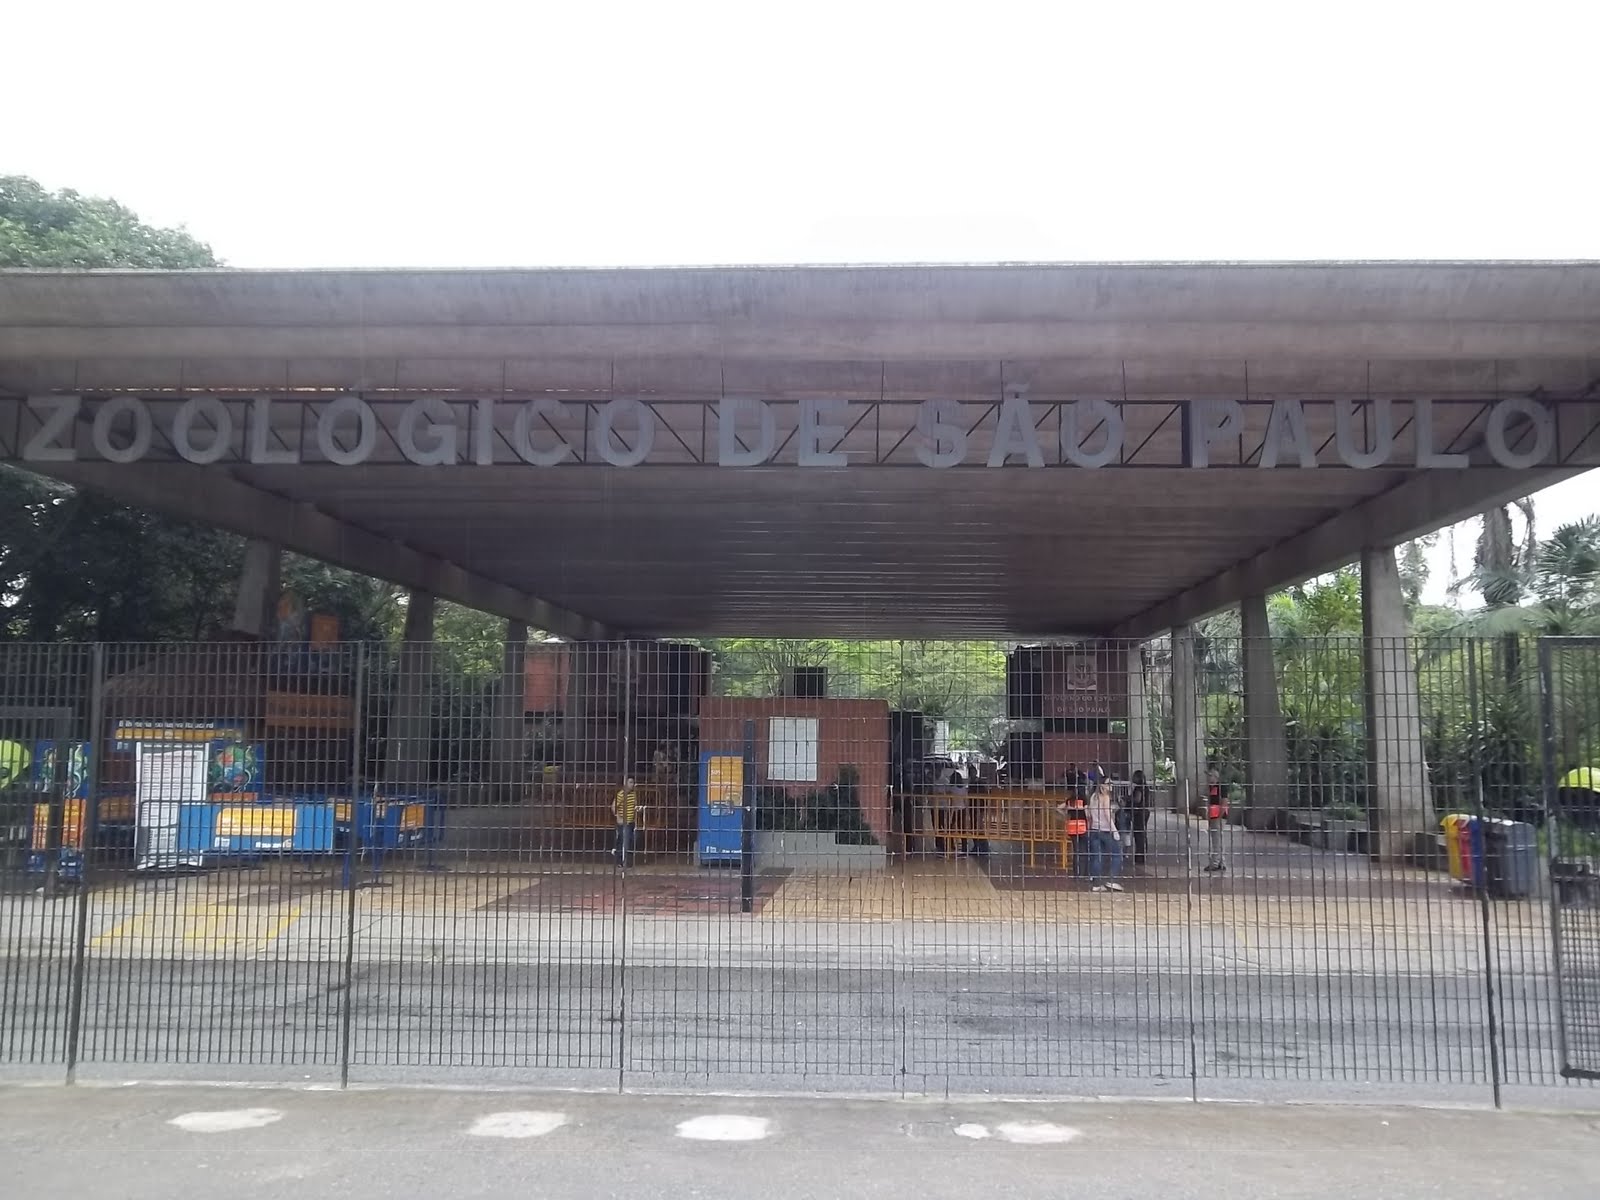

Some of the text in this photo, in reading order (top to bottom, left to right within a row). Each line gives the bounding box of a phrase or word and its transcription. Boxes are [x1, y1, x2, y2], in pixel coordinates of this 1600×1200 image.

[718, 398, 849, 467] DE
[915, 383, 1125, 468] SÃO
[1190, 398, 1553, 469] PAULO
